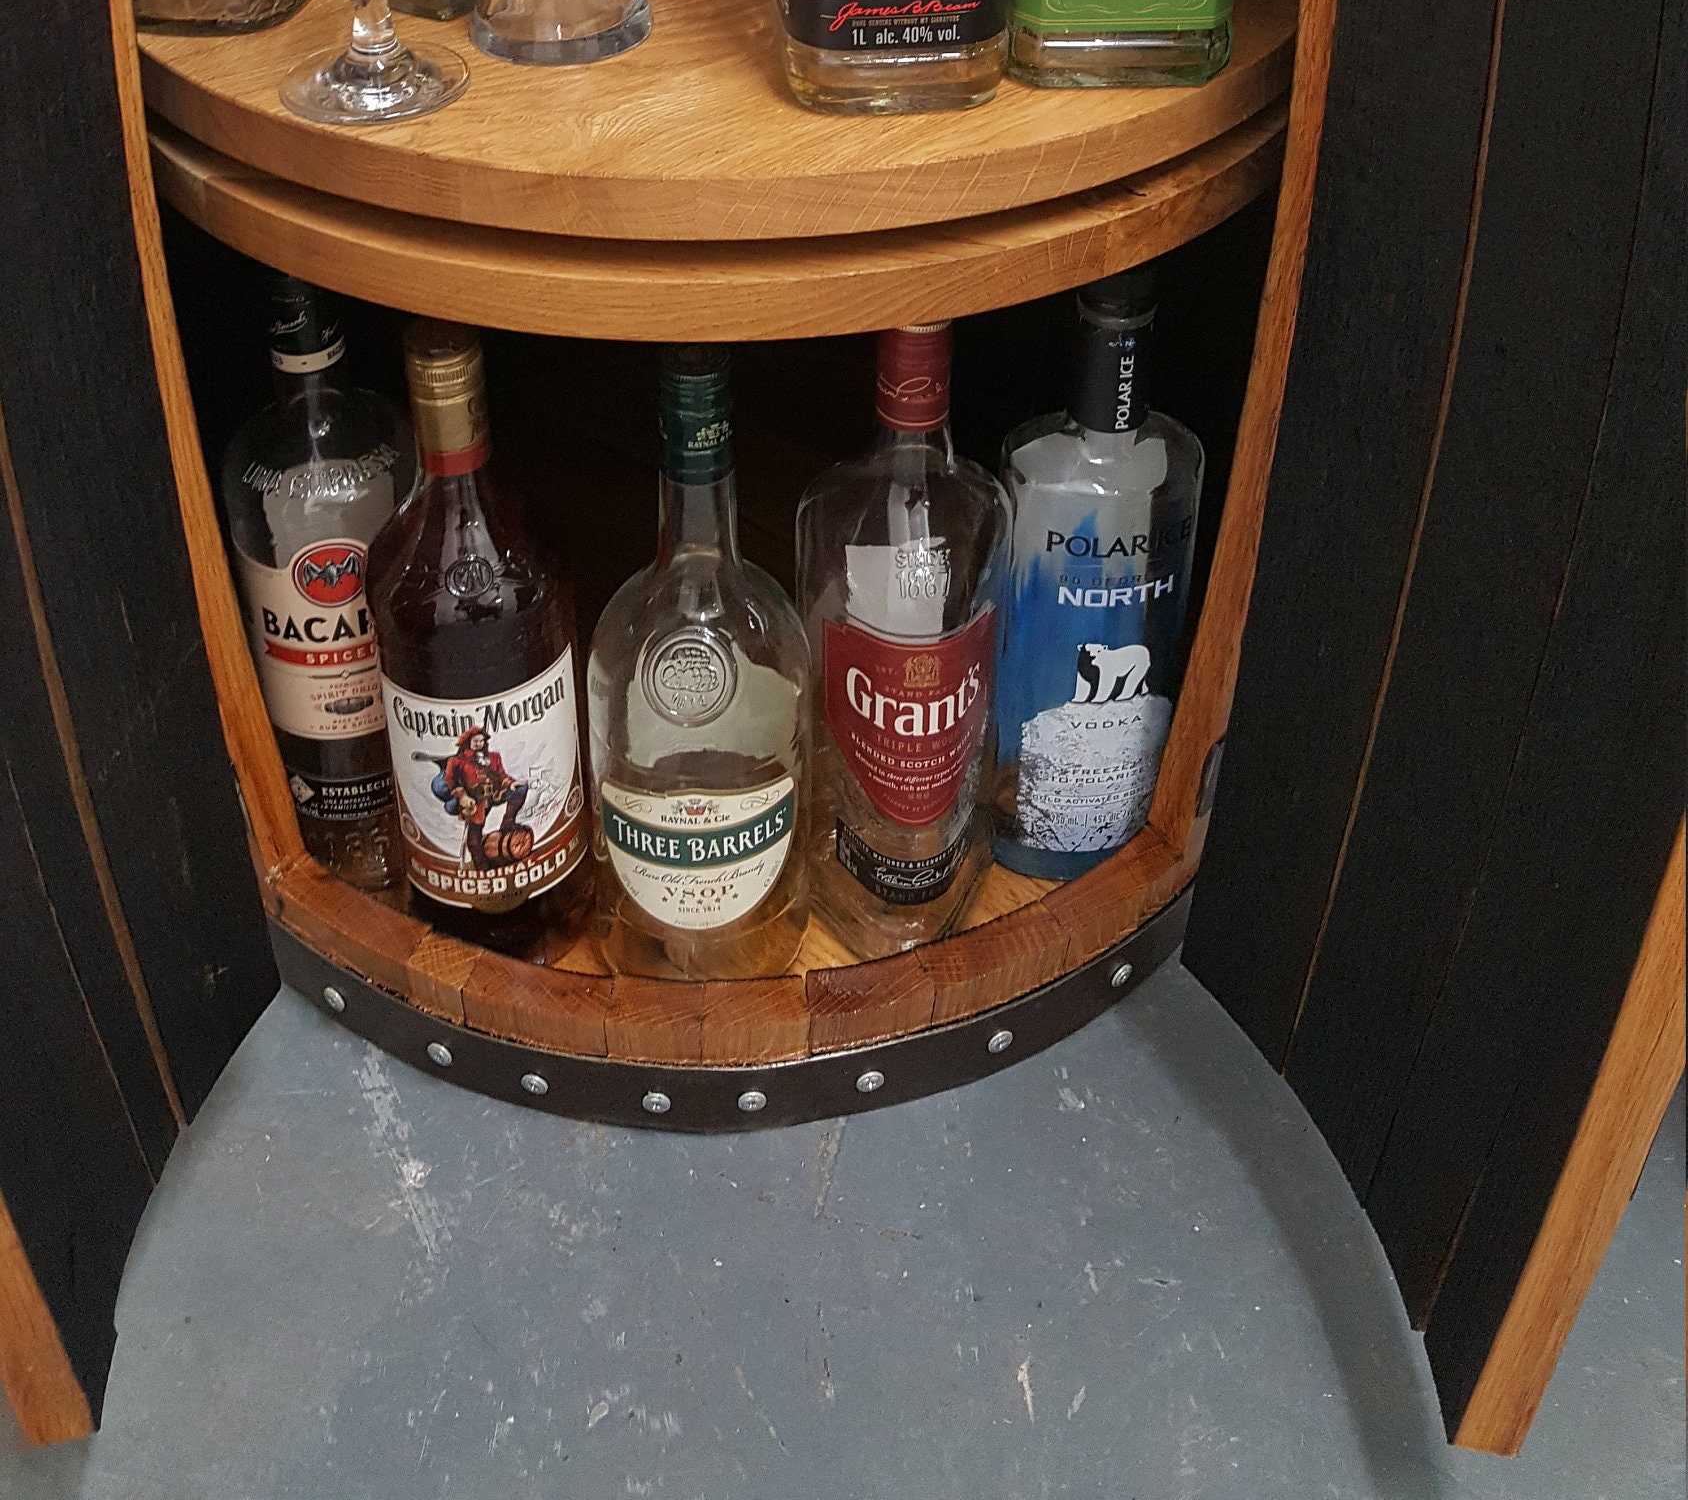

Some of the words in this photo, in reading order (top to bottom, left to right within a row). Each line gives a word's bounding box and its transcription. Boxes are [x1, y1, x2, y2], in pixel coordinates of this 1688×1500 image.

[829, 1, 899, 32] James
[921, 0, 982, 15] Beam
[852, 27, 867, 46] 1L
[875, 27, 899, 45] alc.
[902, 25, 934, 44] 40%
[937, 23, 961, 41] vol.
[1119, 354, 1136, 381] ICE
[1114, 380, 1134, 431] POLAR
[1045, 530, 1150, 559] POLAR
[1057, 573, 1175, 608] NORTH
[261, 606, 375, 644] BACA
[393, 695, 476, 741] Captain
[475, 674, 566, 735] Morgan
[846, 660, 982, 737] Grant's
[1070, 714, 1143, 730] VODKA
[851, 731, 896, 766] BLENDED
[900, 755, 946, 769] SCOTCH
[876, 733, 922, 753] TRIPLE
[321, 777, 386, 798] ESTABLECI
[886, 772, 904, 781] three
[904, 773, 934, 785] different
[900, 783, 915, 792] rich
[916, 782, 930, 791] and
[660, 815, 701, 825] RAYNAL
[702, 815, 712, 824] &
[714, 813, 731, 823] Cie
[611, 813, 681, 860] THREE
[686, 809, 786, 863] BARRELS
[427, 868, 508, 896] SPICED
[514, 848, 568, 889] GOLD
[457, 858, 537, 879] ORIGINAL
[633, 864, 661, 881] Rare
[660, 869, 684, 885] Old
[683, 870, 725, 886] French
[723, 859, 766, 882] Brandy
[664, 883, 735, 899] VSOP
[678, 906, 700, 914] SINCE
